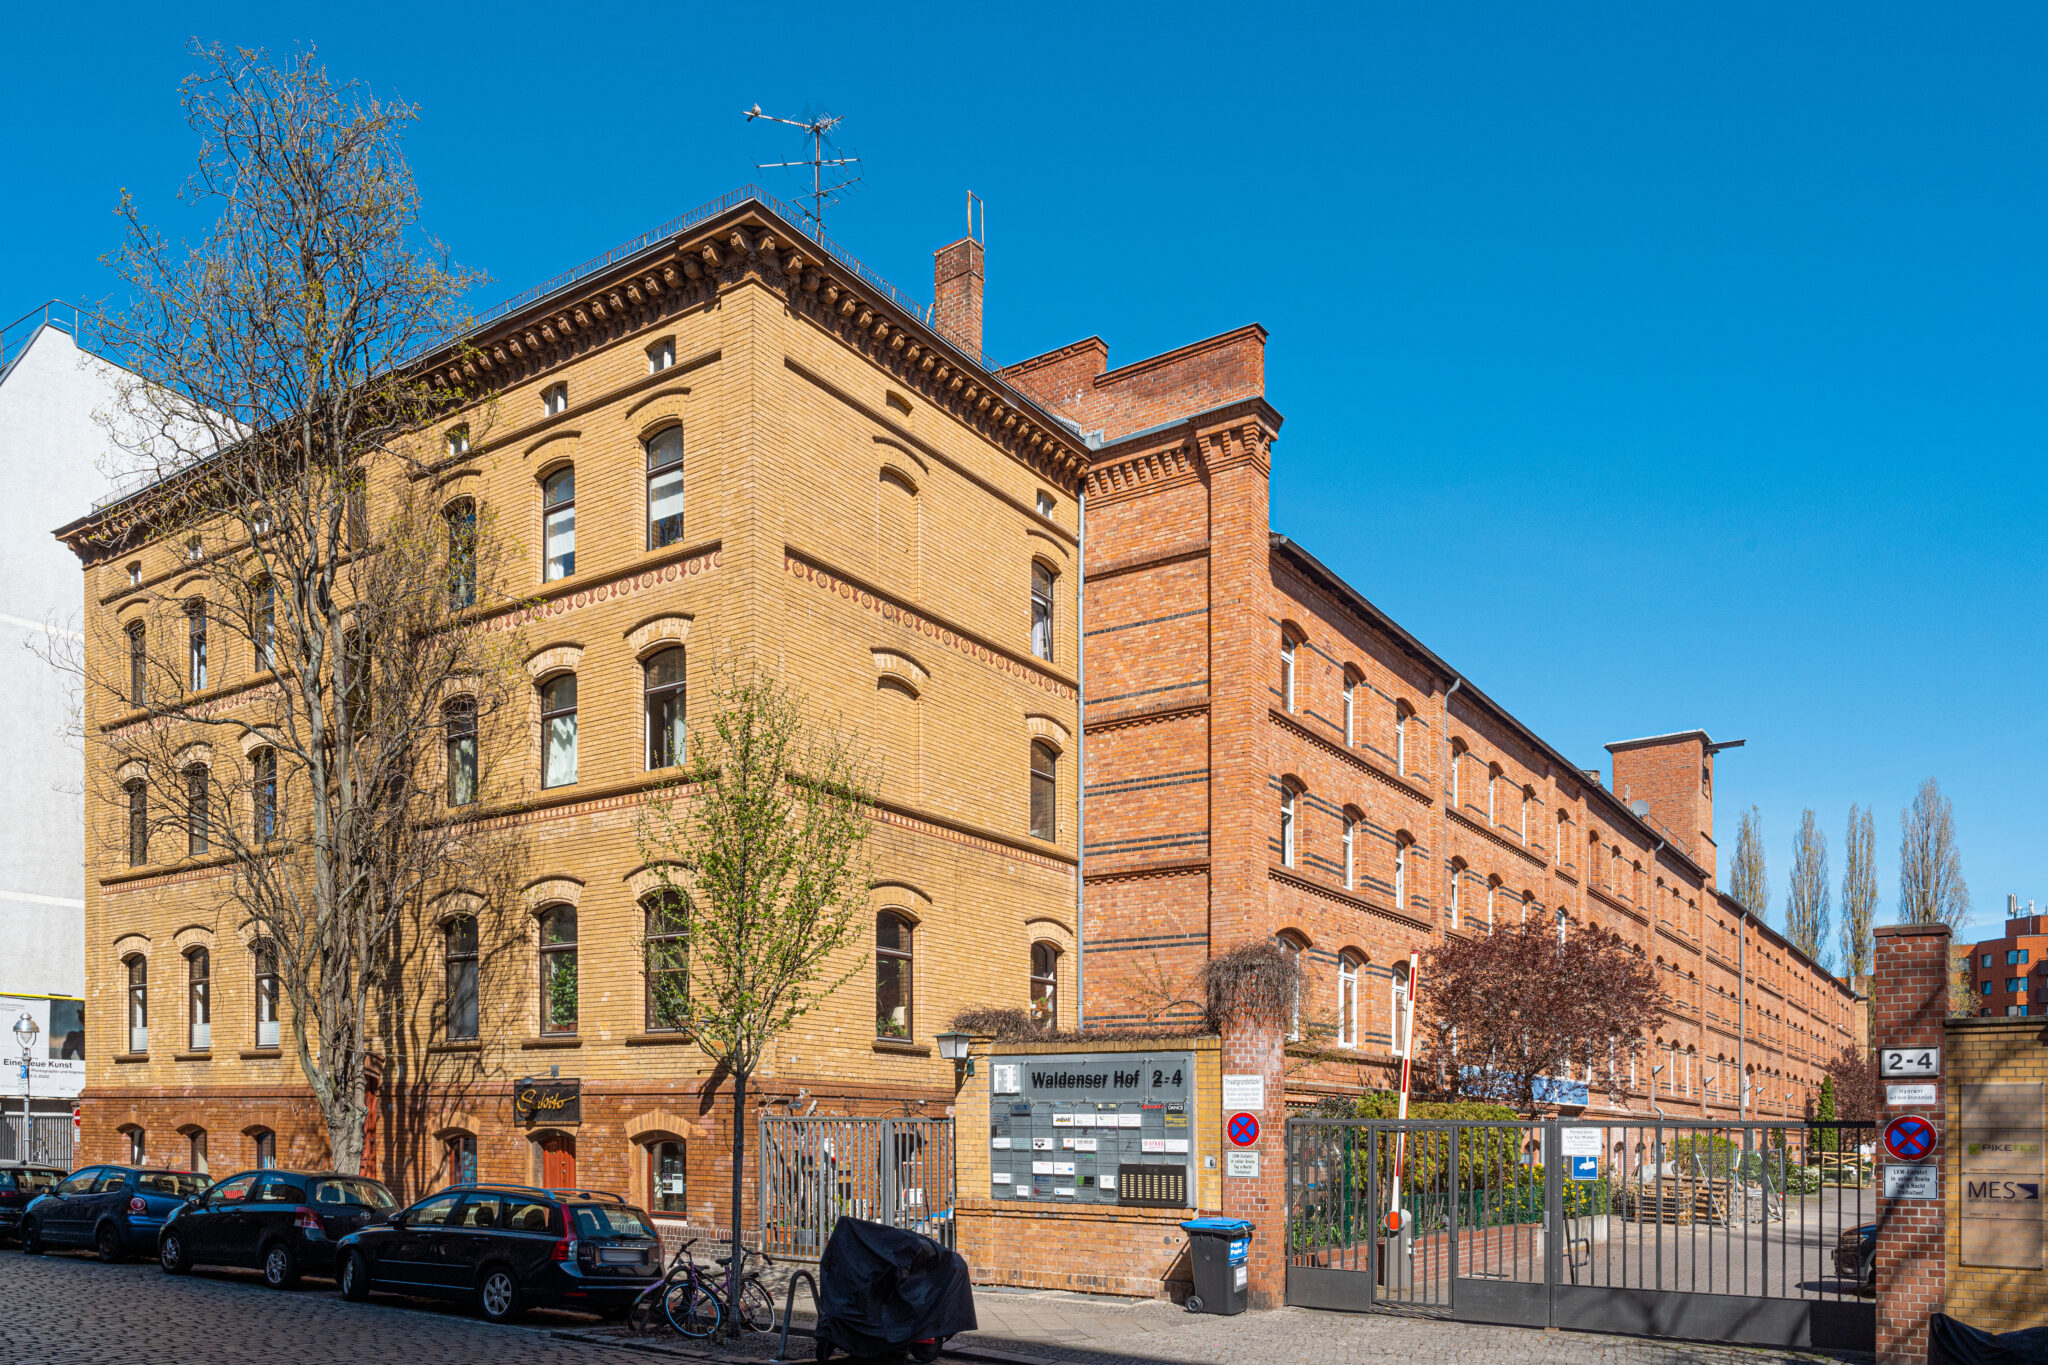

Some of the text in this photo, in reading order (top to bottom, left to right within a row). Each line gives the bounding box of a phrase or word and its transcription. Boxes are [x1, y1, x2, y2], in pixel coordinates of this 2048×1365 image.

[3, 1058, 23, 1066] Eine
[48, 1061, 73, 1069] Kunst
[1889, 1052, 1933, 1070] 2-4
[1032, 1071, 1108, 1087] Waldenser
[1113, 1070, 1140, 1087] Hof
[516, 1089, 576, 1112] Subito
[1982, 1144, 2040, 1152] PIKETEC
[1968, 1181, 2016, 1199] MES
